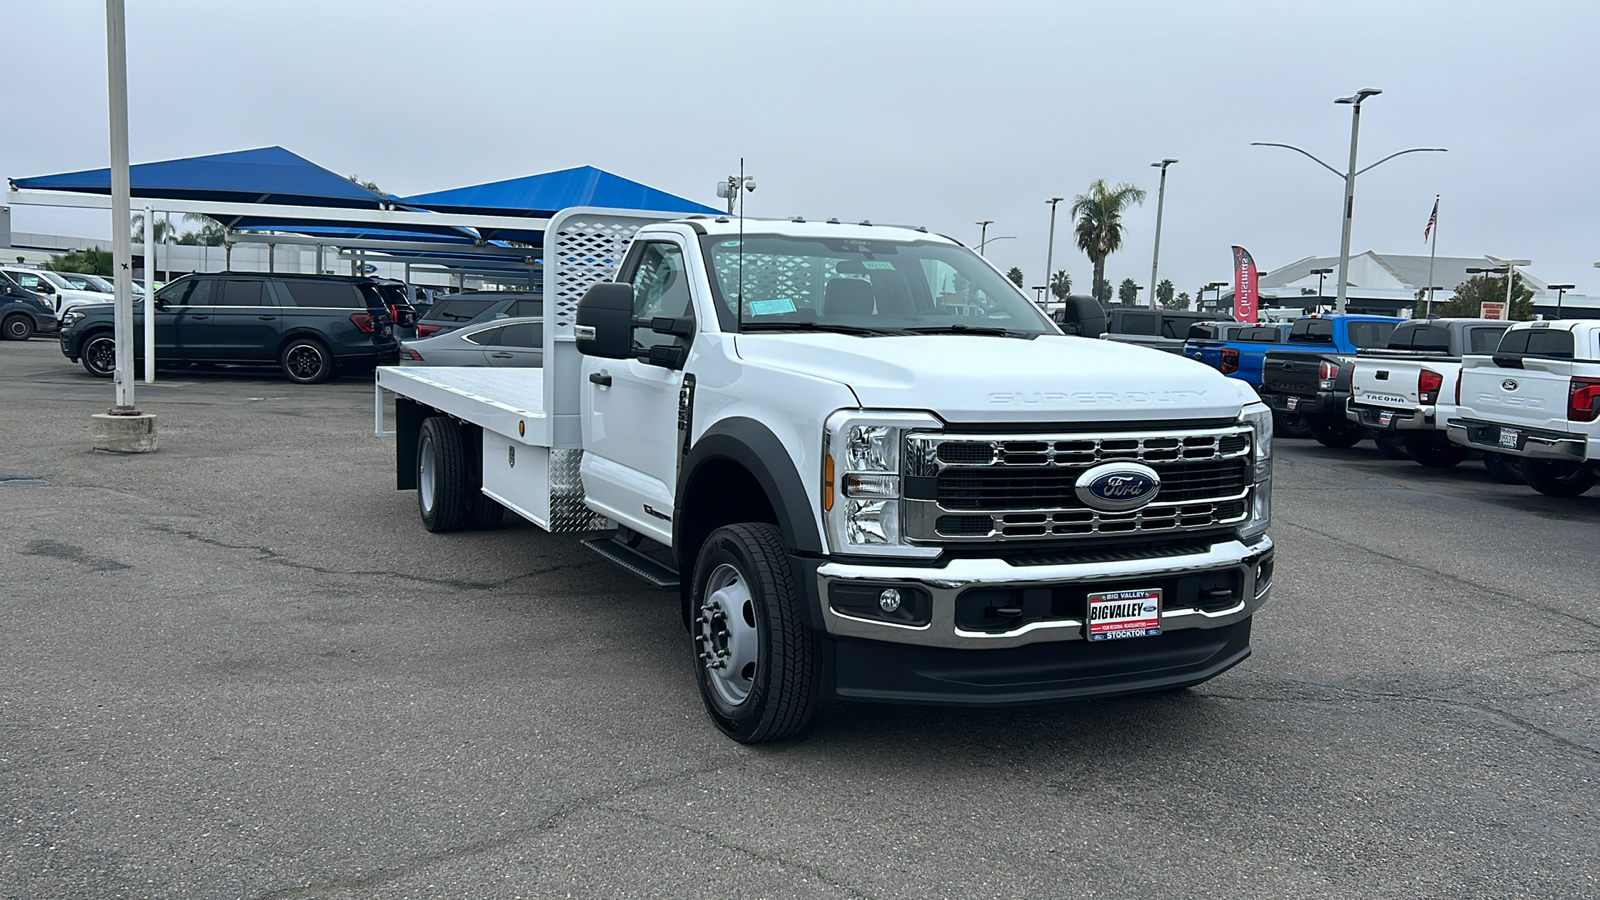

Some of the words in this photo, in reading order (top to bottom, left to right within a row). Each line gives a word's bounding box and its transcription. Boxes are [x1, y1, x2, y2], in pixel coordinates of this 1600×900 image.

[988, 391, 1121, 405] SUPER
[1127, 390, 1208, 404] DUTY
[1366, 394, 1405, 403] TACOMA
[1103, 476, 1143, 497] Ford
[1120, 591, 1145, 599] VALLEY
[1106, 629, 1146, 640] STOCKTON
